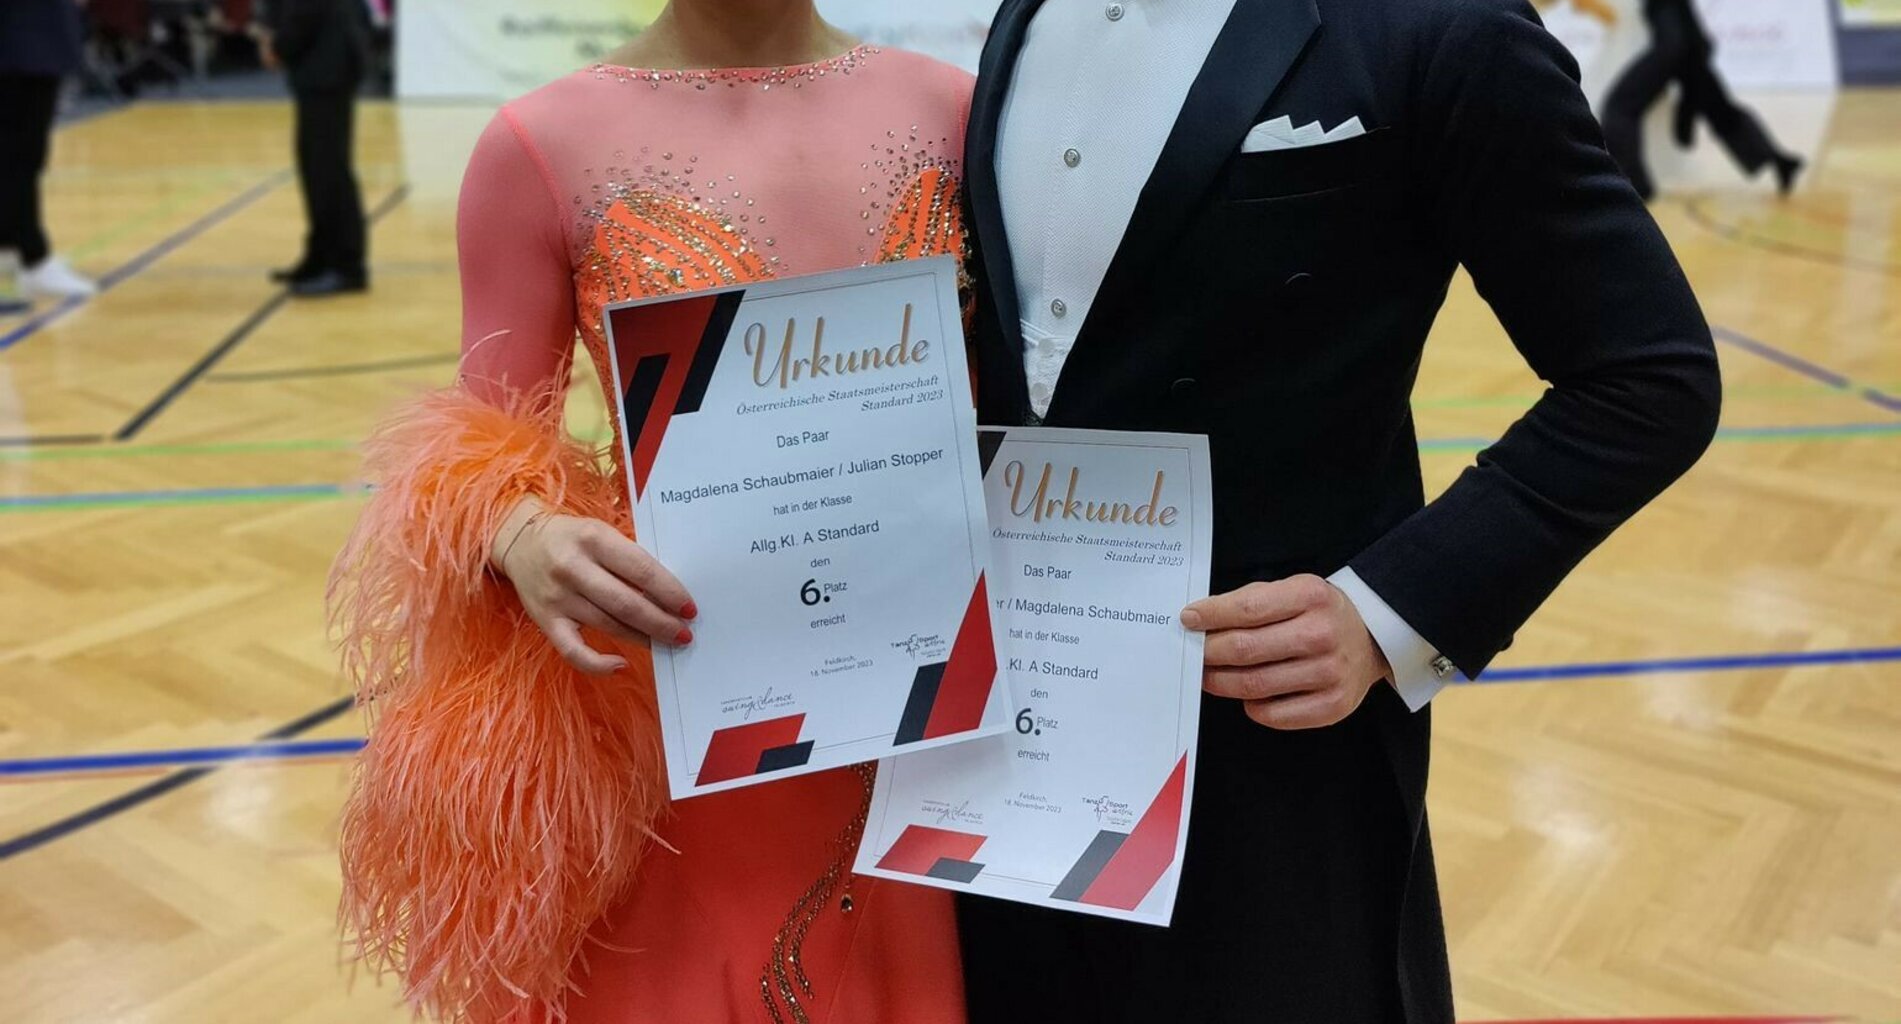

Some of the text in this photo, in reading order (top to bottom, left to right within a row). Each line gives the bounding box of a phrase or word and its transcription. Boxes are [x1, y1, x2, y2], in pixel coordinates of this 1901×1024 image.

[743, 303, 930, 389] Urkunde
[736, 375, 939, 415] Österreichische Staatsmeisterschaft
[861, 389, 944, 412] Standard 2023
[776, 430, 830, 448] Das Paar
[660, 449, 944, 504] Magdalena Schaubmaier / Julian Stopper
[1004, 460, 1180, 527] Urkunde
[773, 494, 852, 516] hat in der Klasse
[750, 520, 879, 554] Allg.Kl. A Standard
[1075, 534, 1182, 552] Staatsmeisterschaft
[810, 557, 830, 568] den
[1104, 551, 1184, 567] Standard 2023
[1023, 564, 1071, 580] Das Paar
[800, 578, 848, 606] 6. Platz
[1015, 598, 1084, 617] Magdalena
[1088, 605, 1172, 625] Schaubmaier
[810, 614, 846, 629] erreicht
[1009, 628, 1080, 644] hat in der Klasse
[821, 664, 855, 676] November
[857, 658, 873, 669] 2023
[1029, 660, 1039, 673] A
[1042, 661, 1099, 679] Standard
[1030, 688, 1048, 699] den
[1015, 708, 1058, 736] 6. Platz
[1017, 748, 1050, 762] erreicht
[1013, 800, 1045, 811] November
